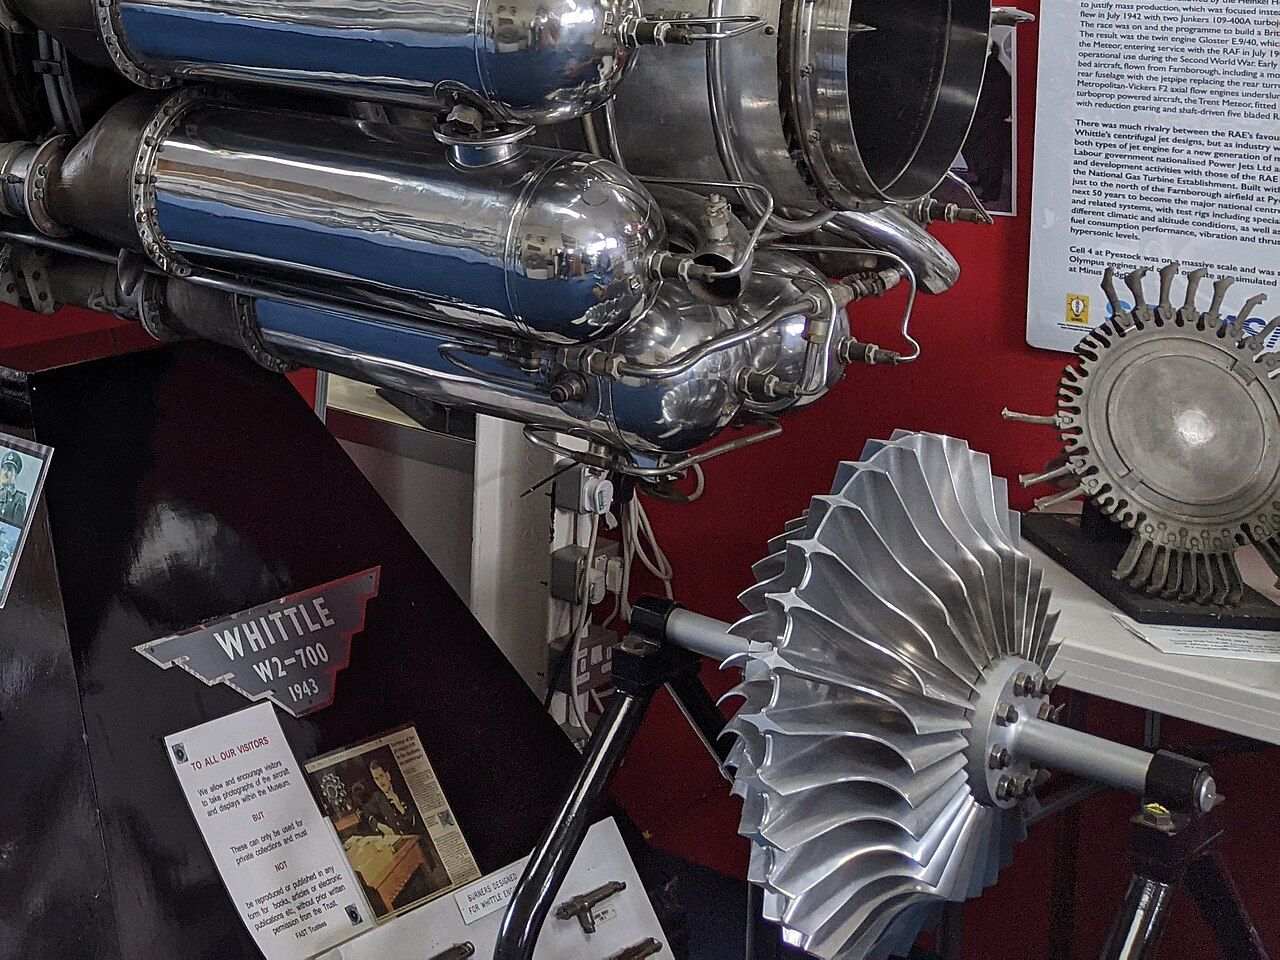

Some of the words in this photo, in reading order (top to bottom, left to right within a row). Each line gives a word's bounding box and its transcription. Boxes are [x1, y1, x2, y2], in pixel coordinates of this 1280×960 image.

[1075, 119, 1099, 127] There
[1144, 125, 1170, 134] rivalry
[1173, 127, 1209, 136] between
[1228, 131, 1253, 139] RAE's
[1075, 129, 1111, 138] Whittle's
[1113, 133, 1156, 143] centrifugal
[1172, 137, 1204, 146] designs,
[1207, 139, 1221, 147] but
[1235, 142, 1270, 152] industry
[1069, 256, 1104, 266] Olympus
[1236, 275, 1277, 286] simulated
[1070, 246, 1085, 254] Cell
[1105, 250, 1141, 260] Pyestock
[1182, 260, 1214, 268] massive
[1258, 268, 1275, 276] was
[1079, 267, 1102, 275] Minus
[213, 597, 335, 661] WHITTLE
[253, 643, 329, 683] W2-700
[288, 678, 319, 702] 1943
[190, 760, 202, 771] TO
[205, 755, 219, 766] ALL
[220, 748, 237, 760] OUR
[236, 736, 269, 754] VISITORS
[197, 788, 208, 796] We
[210, 783, 223, 792] allow
[225, 777, 236, 786] and
[236, 767, 263, 782] encourage
[264, 760, 282, 771] visitors
[208, 795, 221, 804] take
[222, 782, 254, 800] photographs
[255, 777, 261, 786] of
[261, 776, 271, 784] the
[272, 767, 290, 780] aircraft
[207, 806, 218, 817] and
[219, 799, 240, 812] displays
[241, 792, 257, 803] within
[257, 789, 267, 797] the
[267, 780, 291, 792] Museum.
[251, 811, 264, 822] BUT
[229, 843, 248, 854] These
[249, 838, 260, 847] can
[260, 833, 272, 842] only
[281, 822, 295, 833] used
[295, 820, 303, 828] for
[236, 852, 254, 866] private
[255, 840, 282, 856] collections
[283, 834, 294, 844] and
[294, 829, 308, 840] must
[274, 860, 288, 872] NOT
[245, 901, 254, 909] be
[254, 886, 285, 905] reproduced
[285, 884, 291, 892] or
[292, 872, 317, 890] published
[324, 865, 334, 874] any
[247, 907, 260, 920] form
[260, 906, 269, 914] for
[272, 898, 291, 909] books,
[291, 888, 310, 901] articles
[318, 873, 342, 889] electronic
[467, 884, 492, 902] BURNERS
[492, 873, 518, 890] DESIGNED
[469, 903, 480, 915] FOR
[481, 893, 503, 911] WHITTLE
[255, 911, 285, 932] publications
[295, 897, 315, 911] without
[315, 892, 327, 903] prior
[328, 884, 346, 896] written
[272, 918, 300, 935] permission
[299, 912, 312, 921] from
[312, 907, 322, 915] the
[322, 900, 338, 910] Trust.
[295, 928, 308, 939] FAST
[307, 921, 327, 933] Trustees
